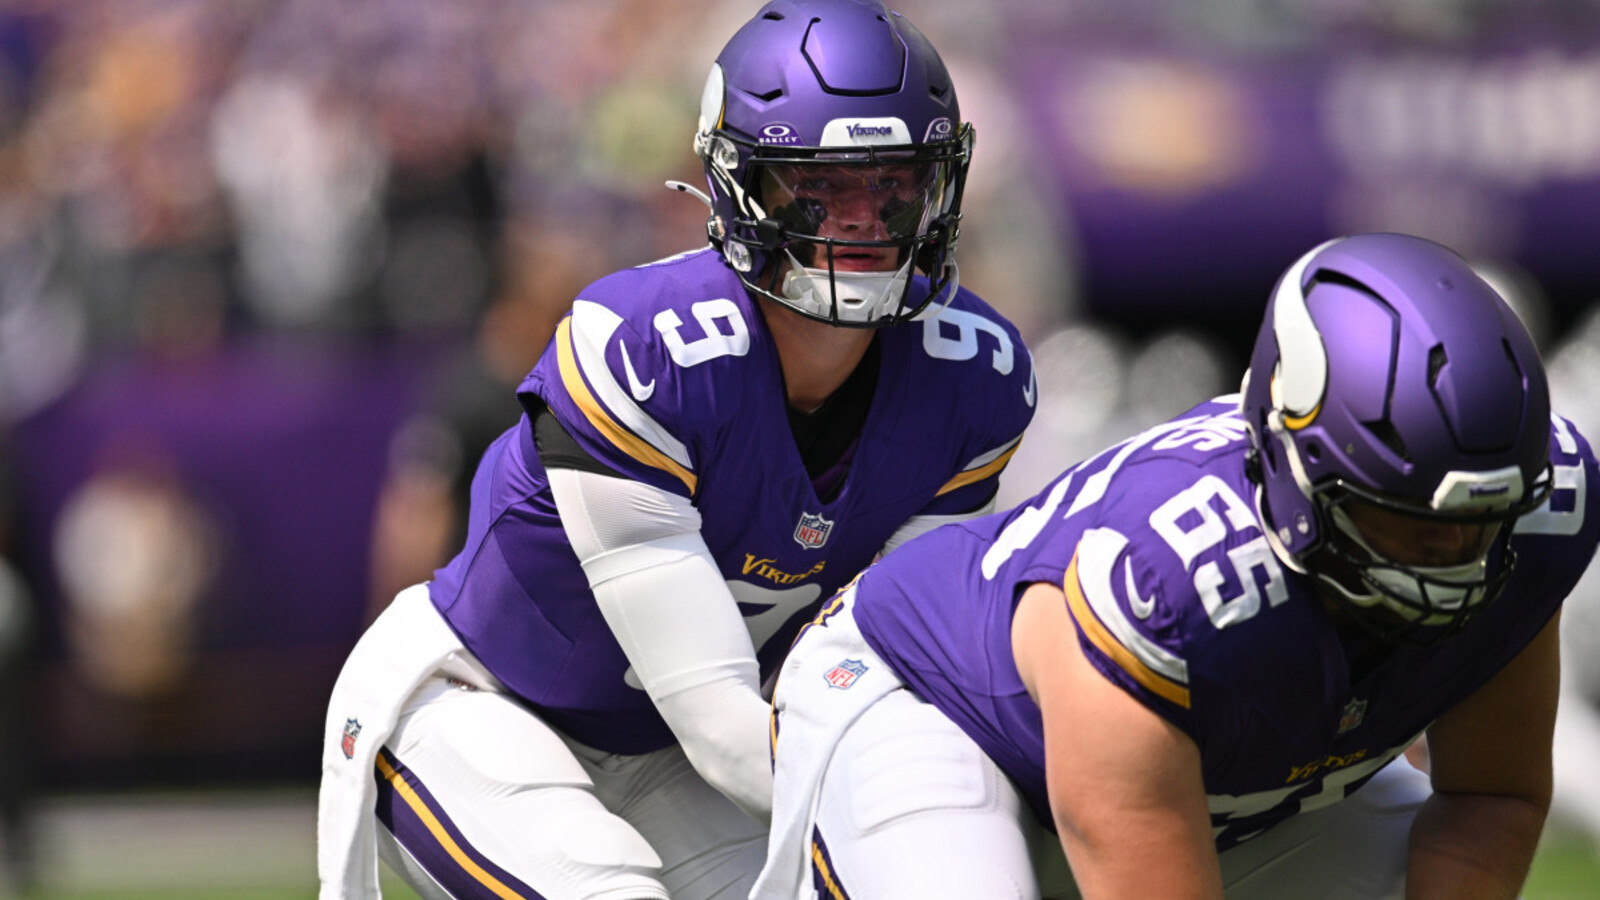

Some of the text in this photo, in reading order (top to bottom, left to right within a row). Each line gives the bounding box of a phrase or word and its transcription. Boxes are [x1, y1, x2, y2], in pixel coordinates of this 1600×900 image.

[654, 298, 750, 368] 9
[799, 526, 822, 544] NFL
[1149, 475, 1289, 630] 65
[826, 666, 856, 688] NFL
